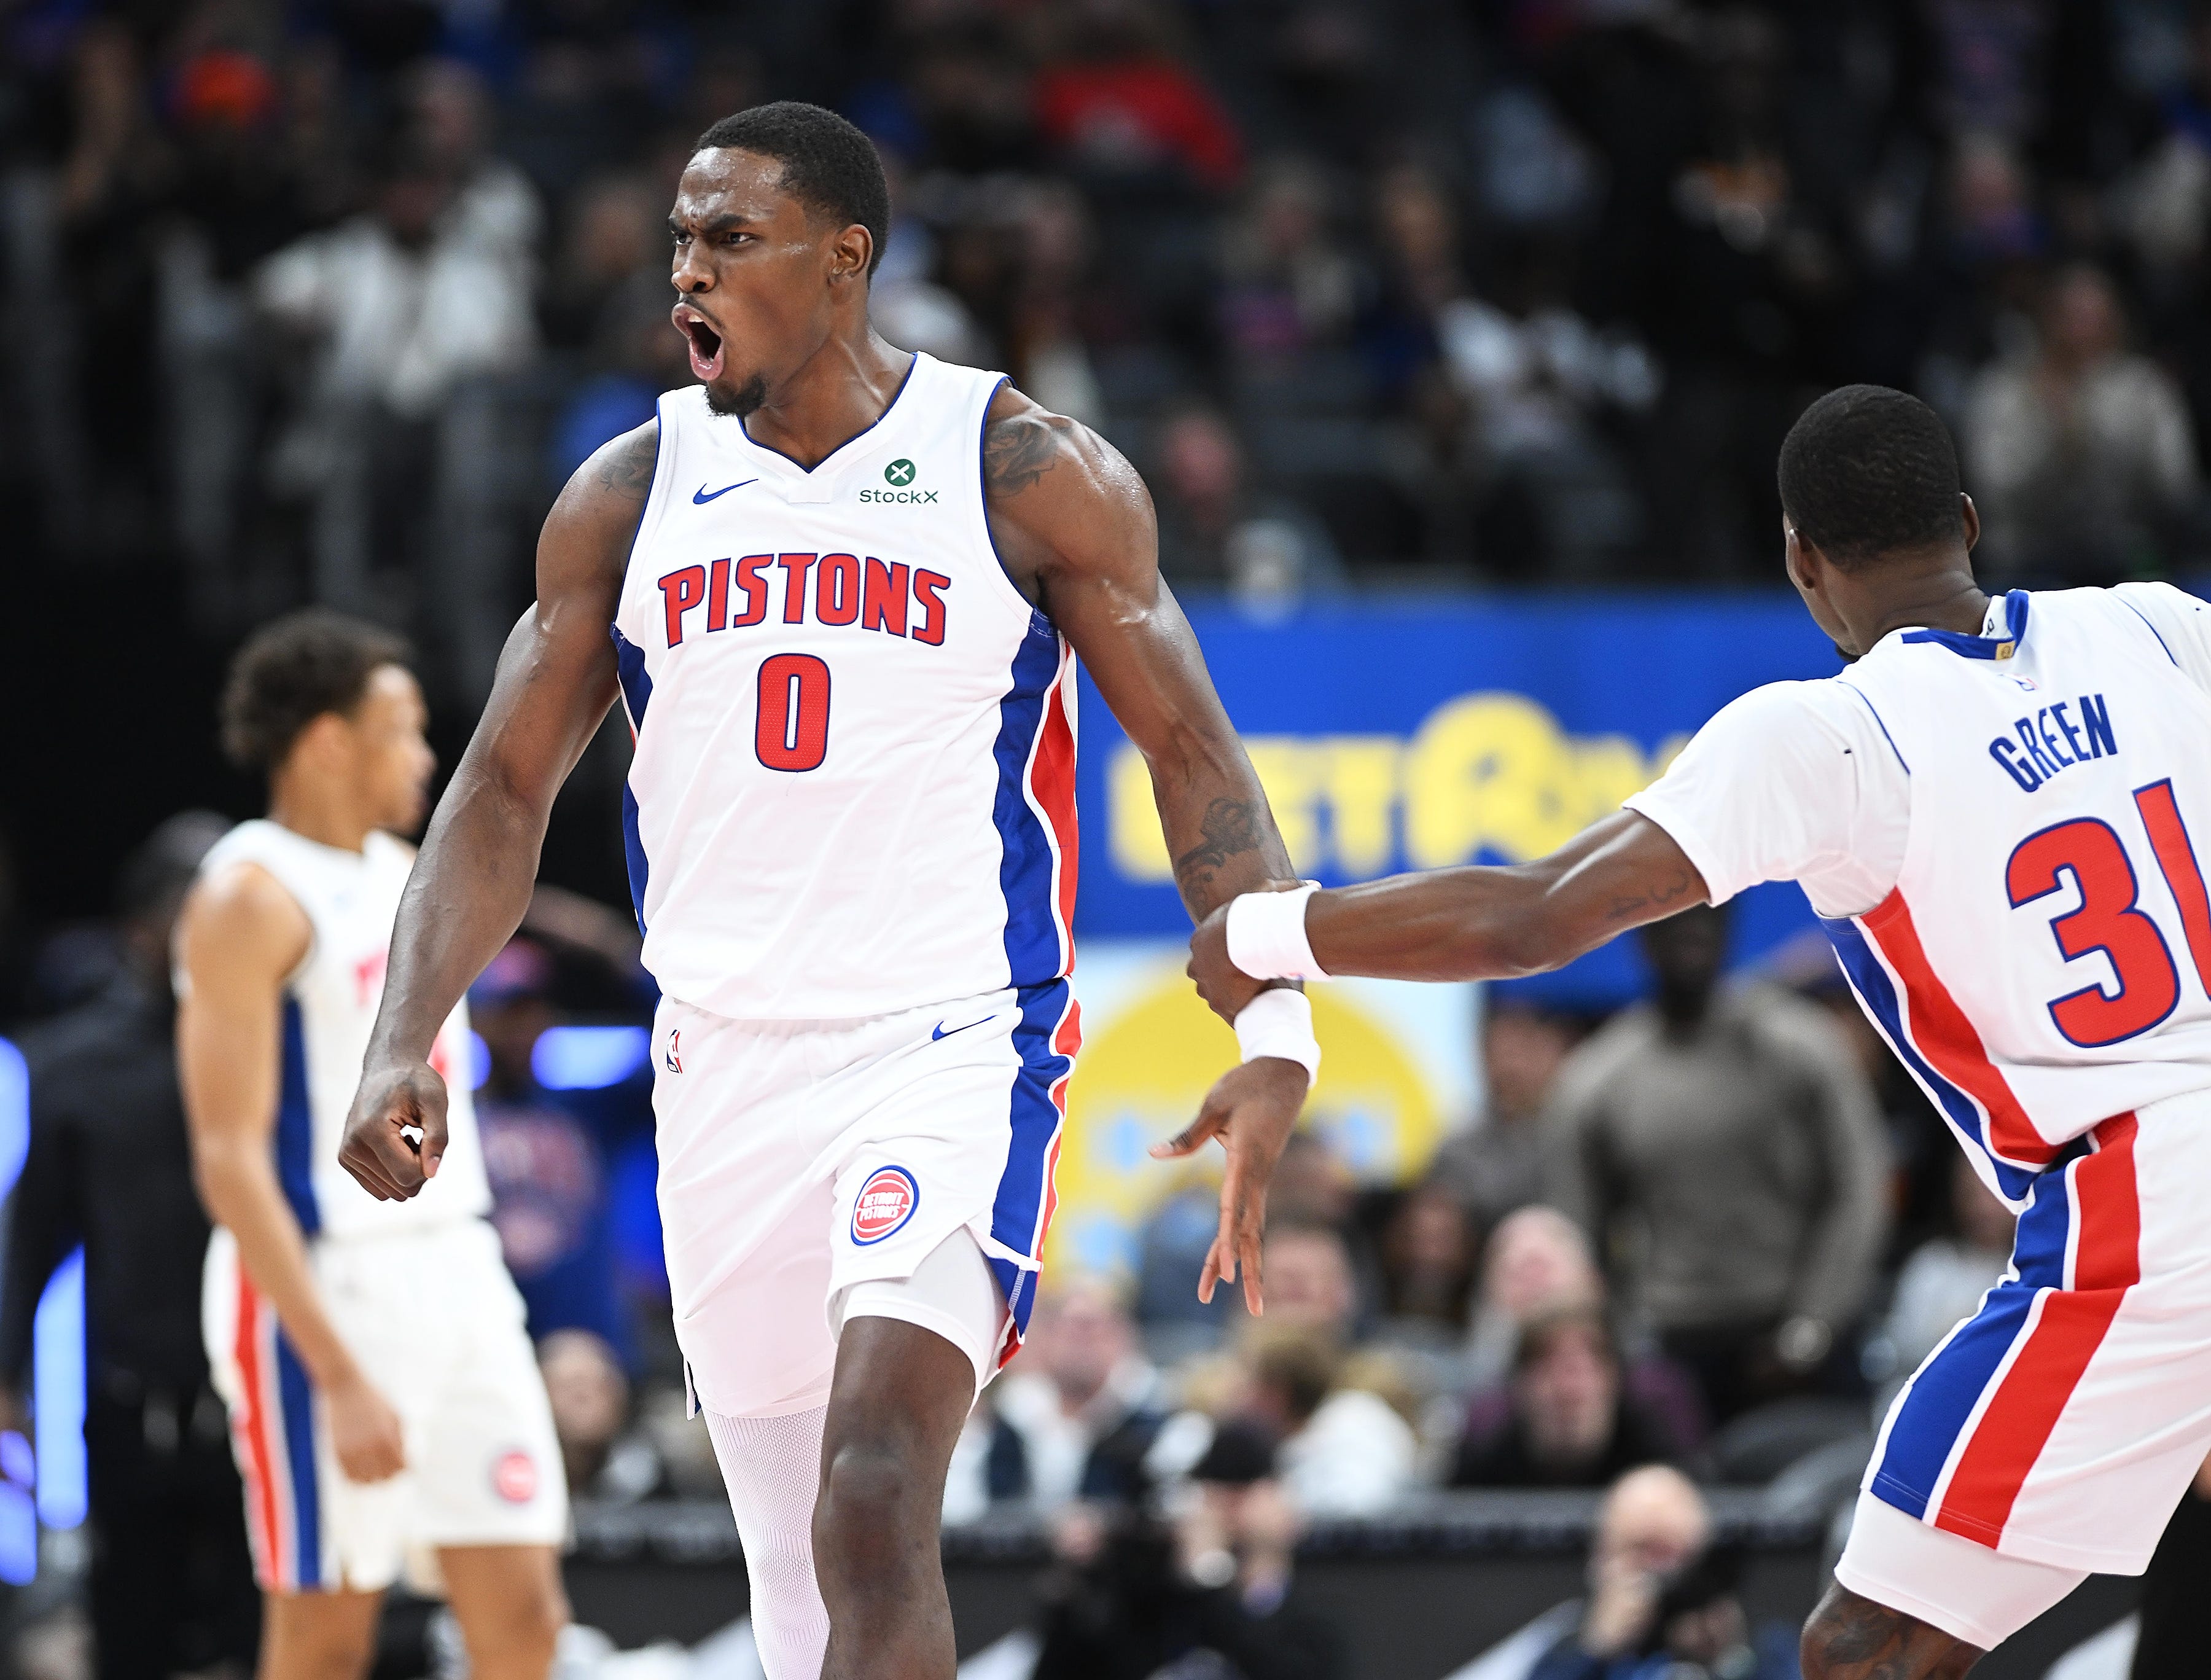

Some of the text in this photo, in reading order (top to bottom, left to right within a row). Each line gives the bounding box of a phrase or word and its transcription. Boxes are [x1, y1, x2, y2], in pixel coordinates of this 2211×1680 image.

[859, 490, 938, 504] StockX
[658, 552, 951, 649] PISTONS
[755, 653, 831, 772] 0
[1989, 693, 2118, 793] GREEN
[2005, 777, 2211, 1048] 31
